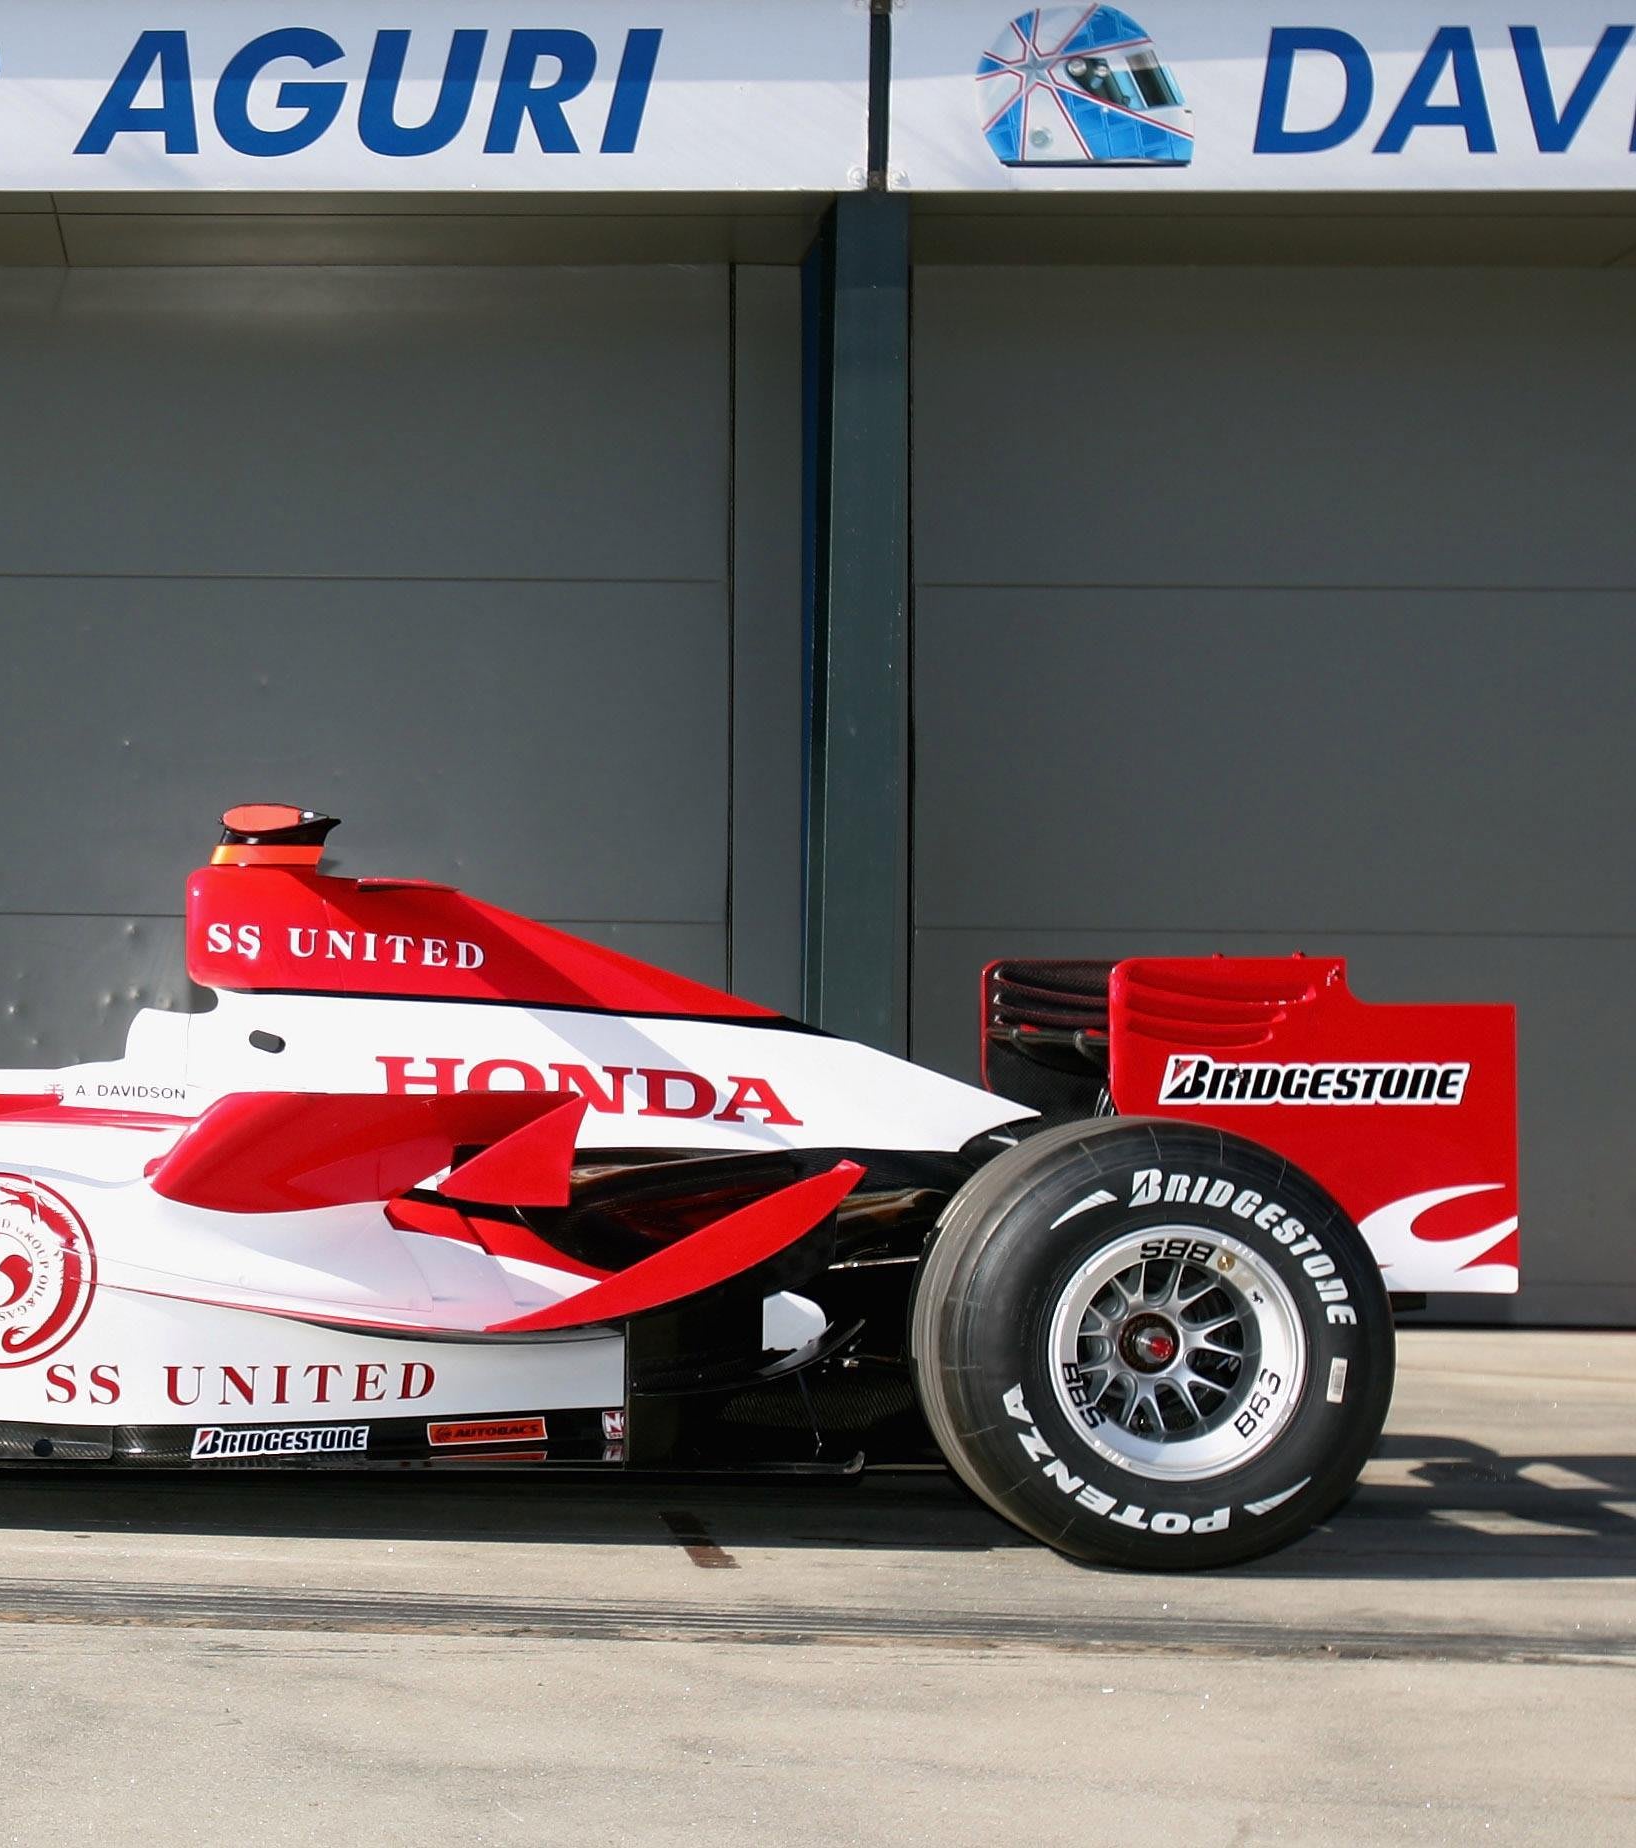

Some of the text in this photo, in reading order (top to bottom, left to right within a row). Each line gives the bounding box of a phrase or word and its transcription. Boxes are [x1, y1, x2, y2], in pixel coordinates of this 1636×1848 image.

[72, 27, 663, 158] AGURI
[1253, 25, 1636, 155] DAV
[207, 922, 485, 970] SS UNITED
[97, 1084, 186, 1100] DAVIDSON
[376, 1056, 803, 1126] HONDA
[1165, 1058, 1465, 1101] BRIDGESTONE
[16, 1226, 49, 1269] GROUP
[1129, 1167, 1357, 1328] BRIDGESTONE
[1140, 1239, 1216, 1265] BBS
[45, 1362, 436, 1406] SS UNITED
[1062, 1362, 1107, 1430] BBS
[194, 1427, 368, 1456] BRIDGESTONE
[1003, 1383, 1231, 1535] POTENZA
